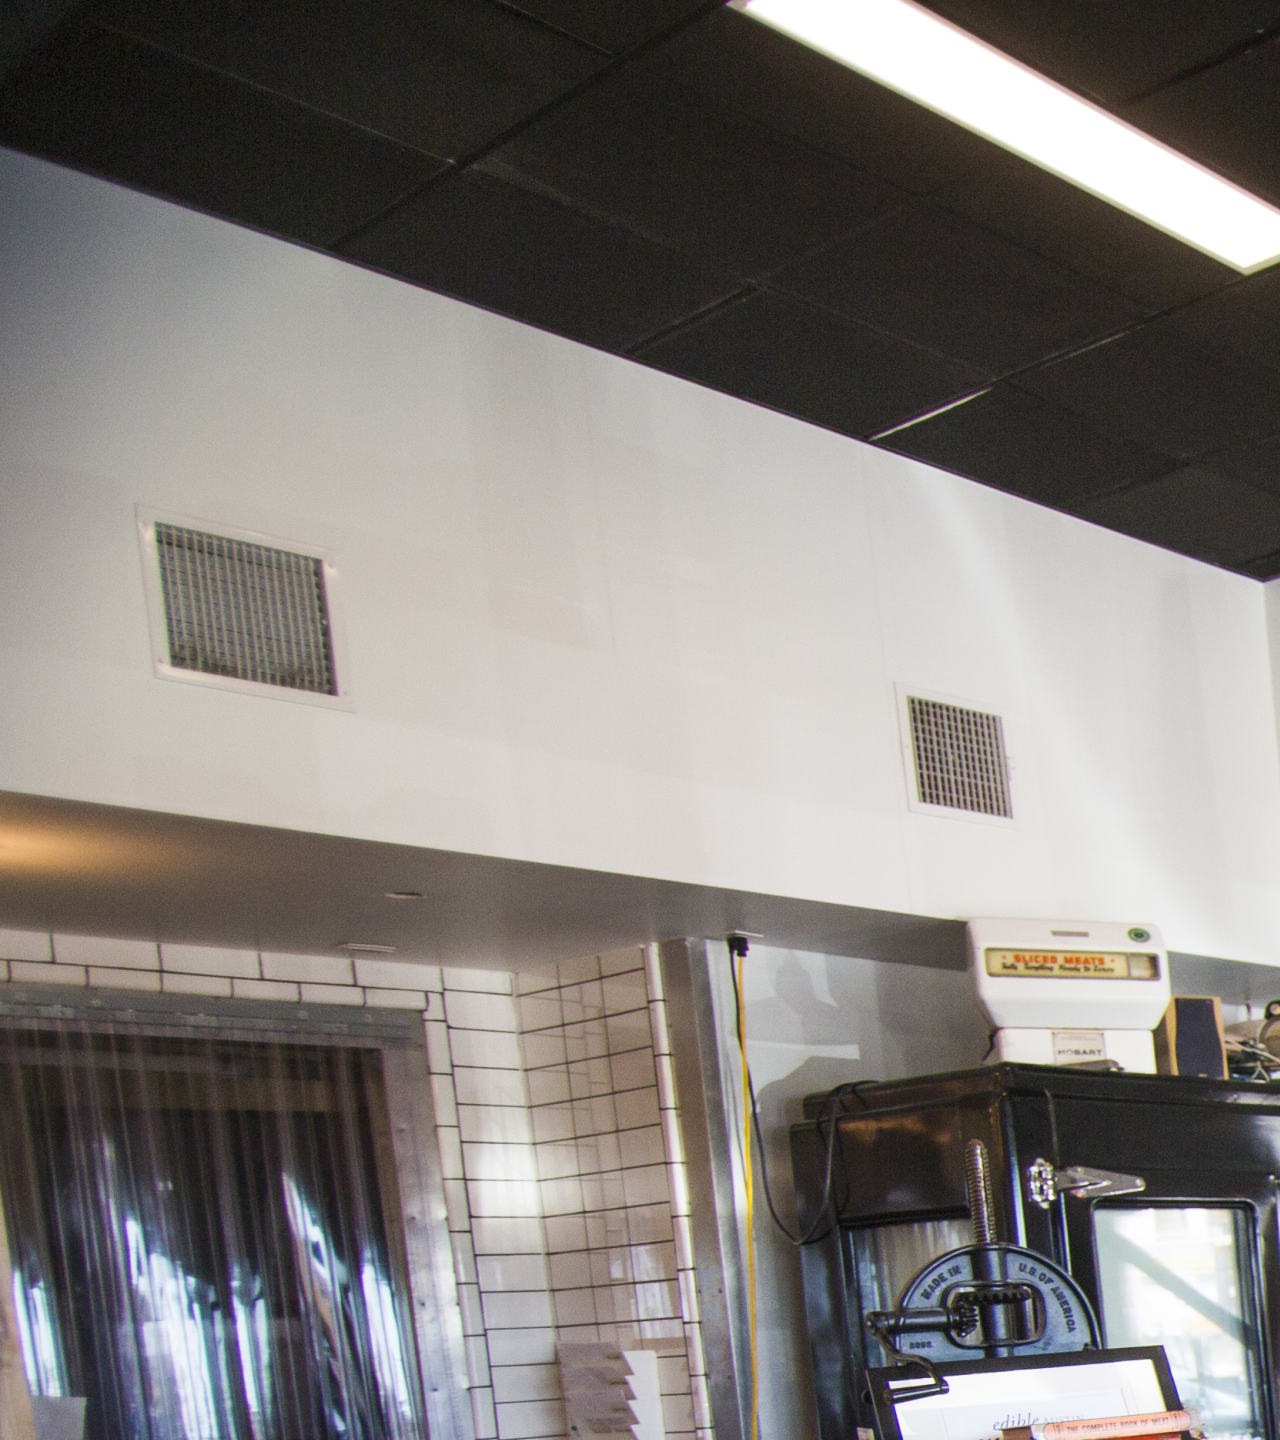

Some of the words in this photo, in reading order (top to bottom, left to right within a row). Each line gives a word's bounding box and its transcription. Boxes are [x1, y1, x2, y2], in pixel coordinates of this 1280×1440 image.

[1013, 954, 1058, 965] SLICED
[1063, 956, 1105, 966] MEATS
[1057, 1048, 1102, 1056] HOBART
[920, 1272, 948, 1300] MADE
[948, 1265, 963, 1277] IN
[1038, 1273, 1055, 1285] OF
[1051, 1286, 1077, 1333] AMERICA
[993, 1411, 1039, 1431] edible
[1066, 1425, 1079, 1433] THE
[1081, 1422, 1117, 1432] COMPLETE
